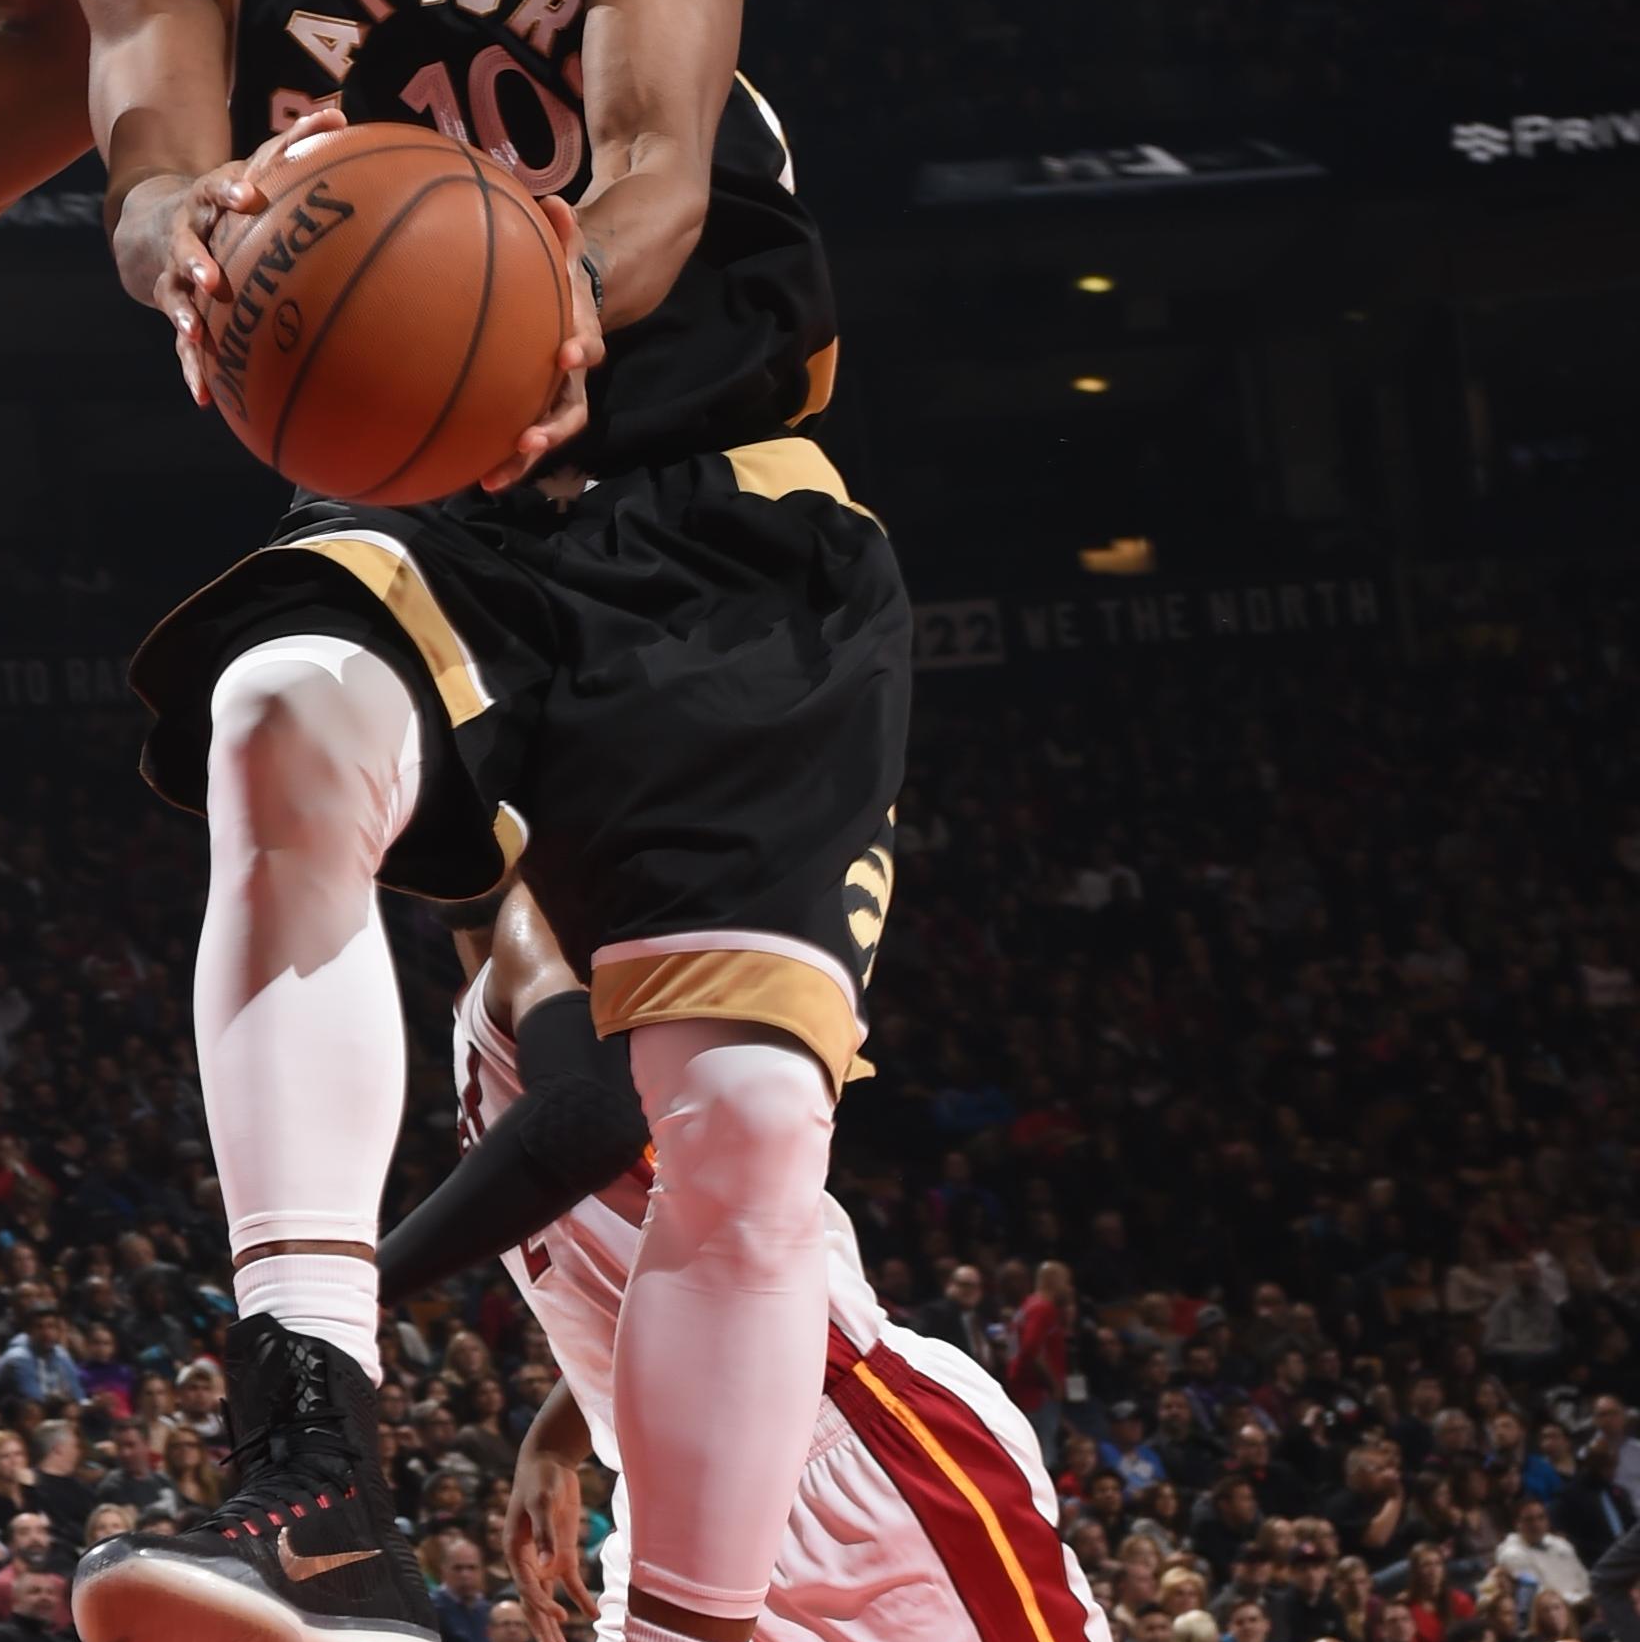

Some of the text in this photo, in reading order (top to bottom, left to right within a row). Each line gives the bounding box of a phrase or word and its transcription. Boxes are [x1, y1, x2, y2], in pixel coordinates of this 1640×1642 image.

[398, 45, 582, 197] 10
[212, 181, 355, 424] SPALDING
[1018, 578, 1379, 651] WE THE NORTH
